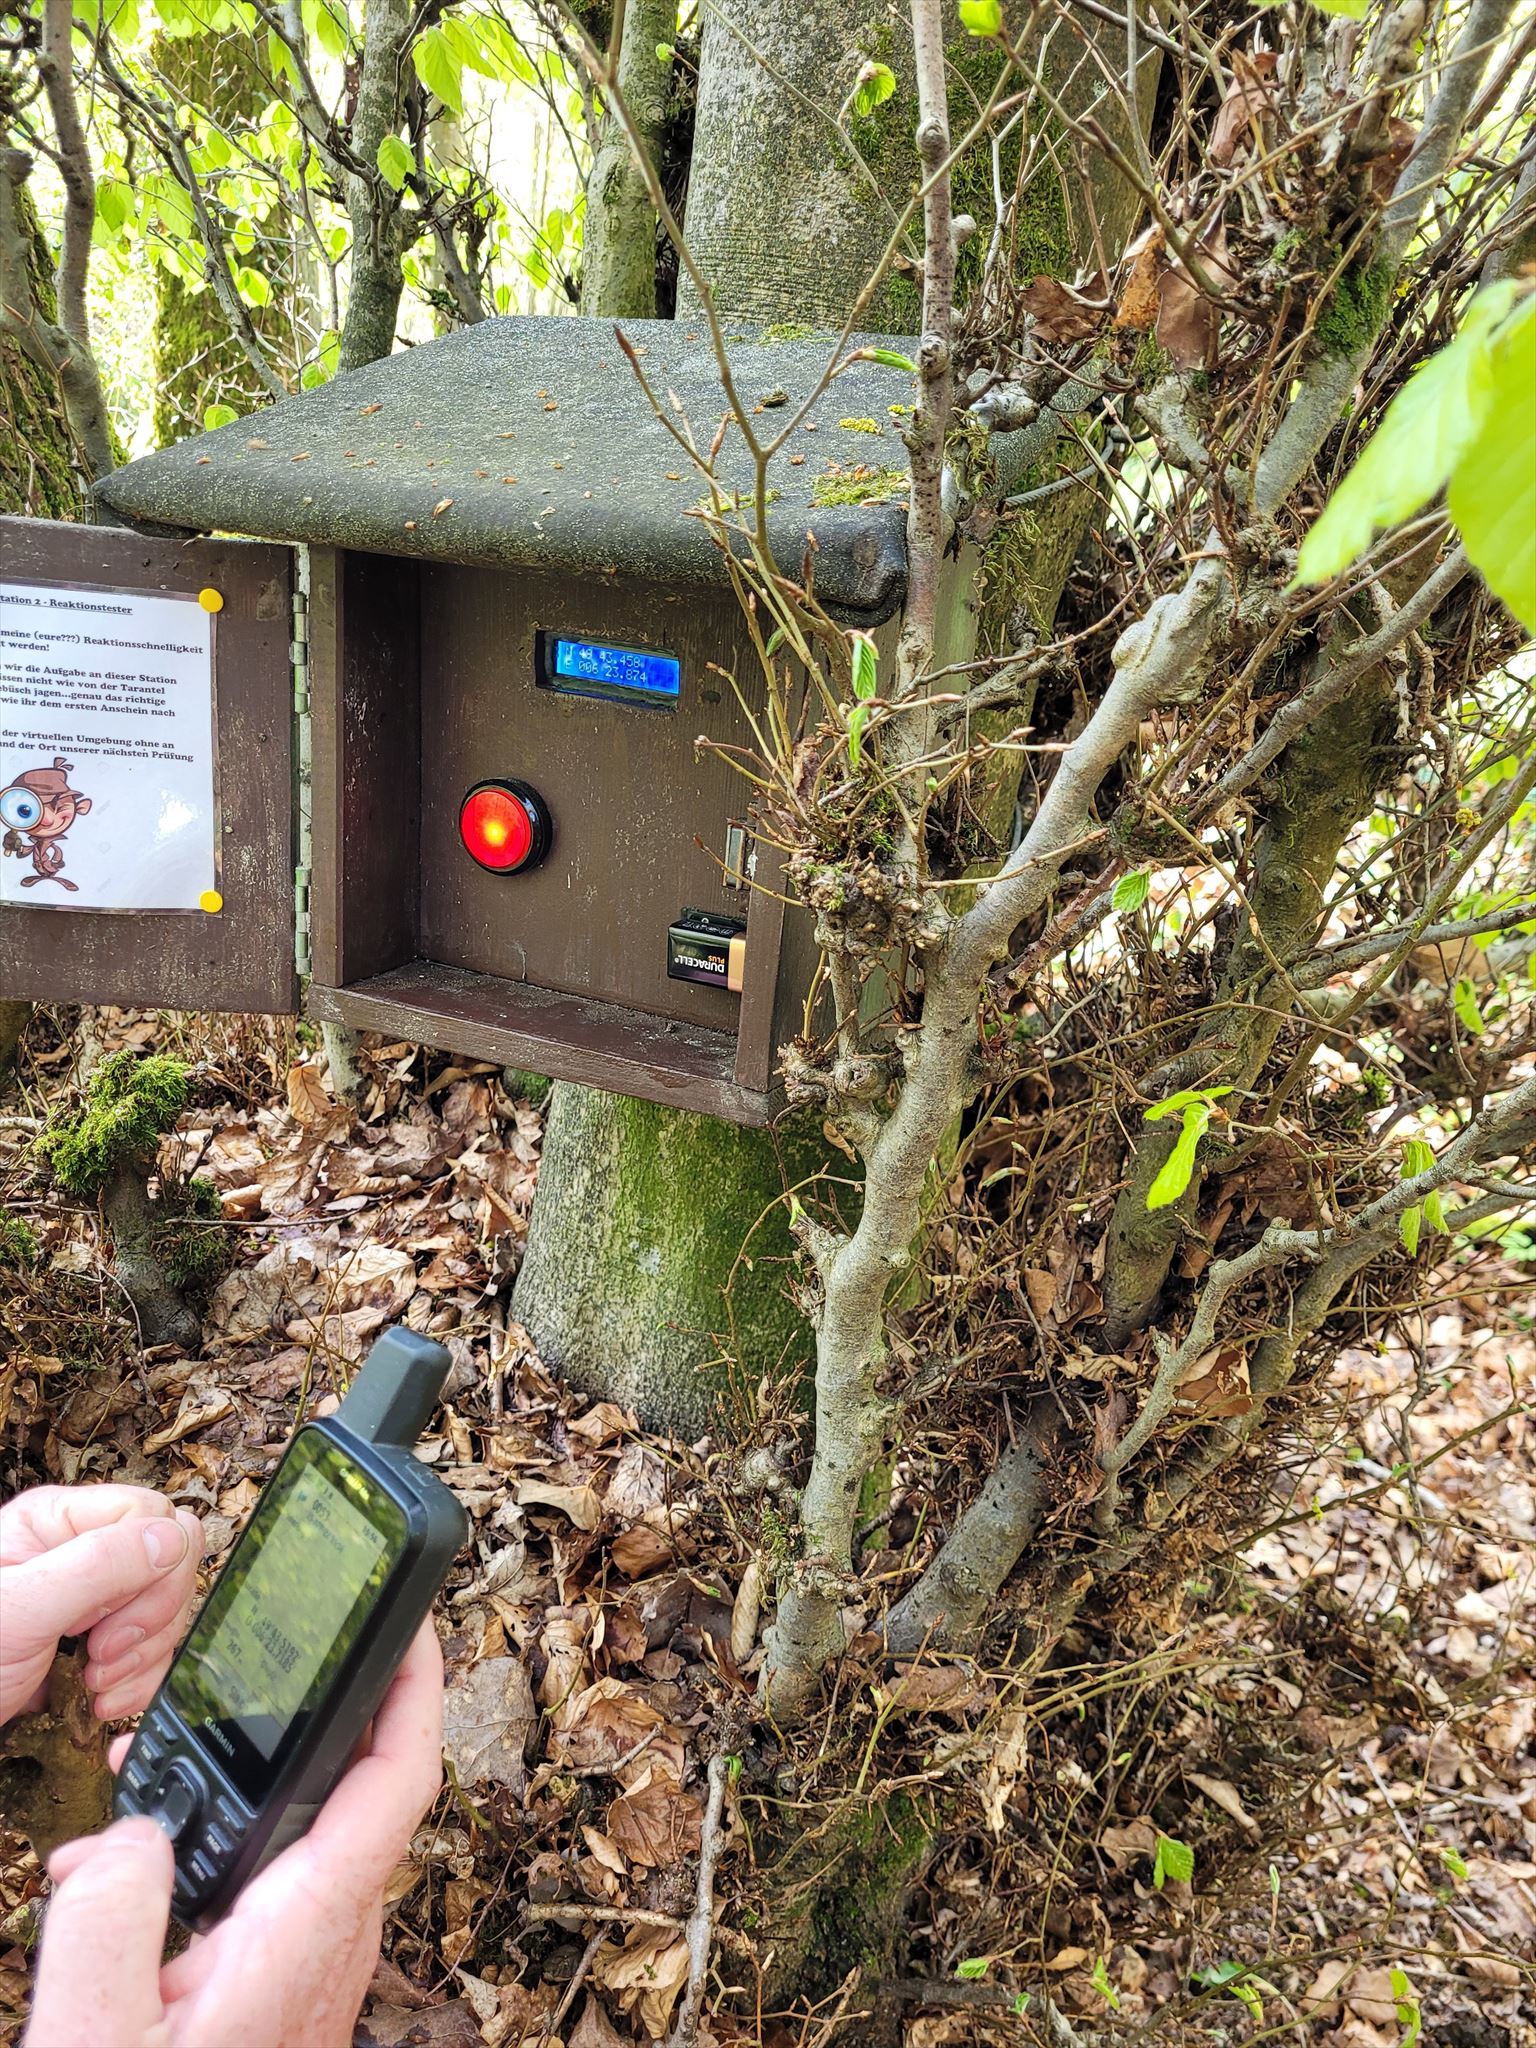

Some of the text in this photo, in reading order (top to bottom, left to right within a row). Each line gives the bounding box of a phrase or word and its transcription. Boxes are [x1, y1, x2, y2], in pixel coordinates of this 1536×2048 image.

[49, 599, 133, 614] Reaktionstester
[1, 630, 203, 654] meine (eure???) Reaktionsschnelligkeit
[9, 642, 50, 652] werden!
[4, 664, 23, 672] wir
[25, 665, 41, 673] die
[43, 667, 87, 677] Aufgabe
[105, 672, 136, 681] dieser
[139, 674, 177, 684] Station
[605, 665, 647, 683] 23.874
[26, 676, 53, 685] nicht
[120, 684, 165, 694] Tarantel
[21, 697, 37, 705] ihr
[40, 700, 61, 708] dem
[64, 702, 97, 711] ersten
[100, 704, 148, 715] Anschein
[151, 708, 176, 717] nach
[125, 695, 166, 706] richtige
[2, 729, 19, 737] der
[22, 731, 73, 742] virtuellen
[76, 735, 132, 747] Umgebung
[134, 740, 160, 748] ohne
[18, 742, 35, 750] der
[38, 743, 57, 751] Ort
[60, 746, 100, 754] unserer
[103, 748, 149, 758] nächsten
[152, 751, 194, 762] Prüfung
[677, 955, 725, 973] DURACELL
[708, 955, 725, 964] PLUS
[205, 1715, 236, 1757] GARMIN
